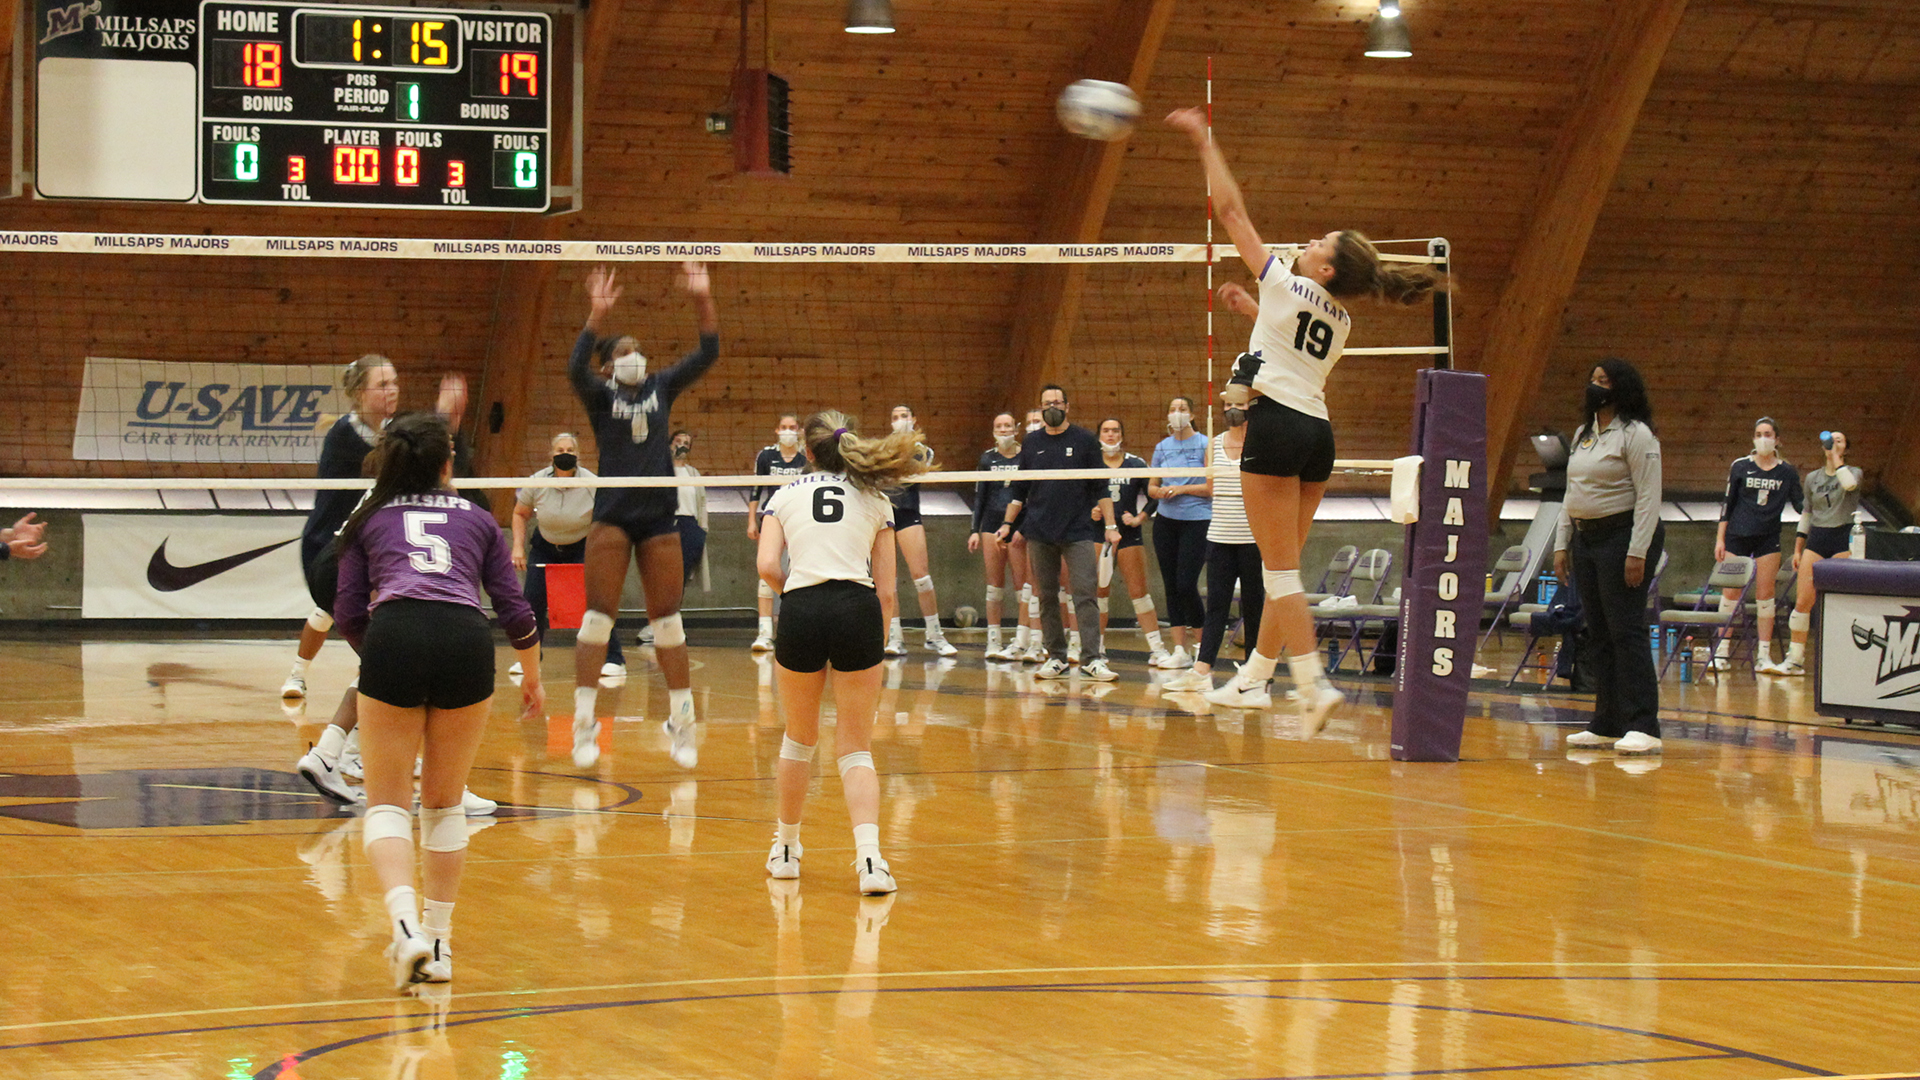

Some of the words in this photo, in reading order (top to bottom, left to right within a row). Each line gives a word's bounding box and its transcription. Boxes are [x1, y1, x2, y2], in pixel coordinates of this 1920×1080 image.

[95, 15, 196, 34] MILLSAPS
[217, 10, 279, 33] HOME
[463, 20, 542, 43] VISITOR
[101, 32, 190, 51] MAJORS
[243, 43, 282, 88] 18
[500, 52, 538, 97] 19
[346, 73, 377, 86] POSS
[242, 95, 294, 112] BONUS
[334, 87, 390, 105] PERIOD
[409, 84, 419, 120] 1
[336, 104, 386, 113] FAIR-PLAY
[460, 103, 510, 120] BONUS
[212, 125, 261, 142] FOULS
[323, 128, 380, 146] PLAYER
[395, 131, 443, 148] FOULS
[493, 134, 540, 150] FOULS
[235, 143, 259, 180] 0
[288, 156, 305, 182] 3
[334, 147, 379, 183] 00
[396, 148, 419, 184] 0
[514, 151, 538, 188] 0
[448, 161, 465, 187] 3
[281, 184, 311, 200] TOL
[441, 188, 470, 205] TOL
[0, 234, 59, 246] MAJORS
[94, 235, 165, 248] MILLSAPS
[170, 237, 230, 249] MAJORS
[266, 239, 334, 251] MILLSAPS
[340, 240, 398, 252] MAJORS
[433, 242, 500, 254] MILLSAPS
[505, 243, 562, 255] MAJORS
[596, 244, 661, 256] MILLSAPS
[665, 245, 722, 256] MAJORS
[754, 245, 817, 257] MILLSAPS
[821, 245, 876, 256] MAJORS
[907, 246, 969, 257] MILLSAPS
[974, 246, 1027, 257] MAJORS
[1058, 246, 1119, 257] MILLSAPS
[1123, 245, 1175, 257] MAJORS
[1290, 281, 1349, 326] MILLSAPS
[1294, 310, 1334, 360] 19
[136, 381, 333, 429] U-SAVE
[124, 431, 160, 445] CAR
[165, 434, 178, 445] &
[185, 433, 244, 447] TRUCK
[246, 435, 313, 447] RENTAL
[1746, 477, 1783, 490] BERRY
[381, 494, 472, 511] ILLSAPS
[812, 485, 845, 523] 6
[403, 511, 453, 574] 5
[1431, 459, 1471, 677] MAJORS
